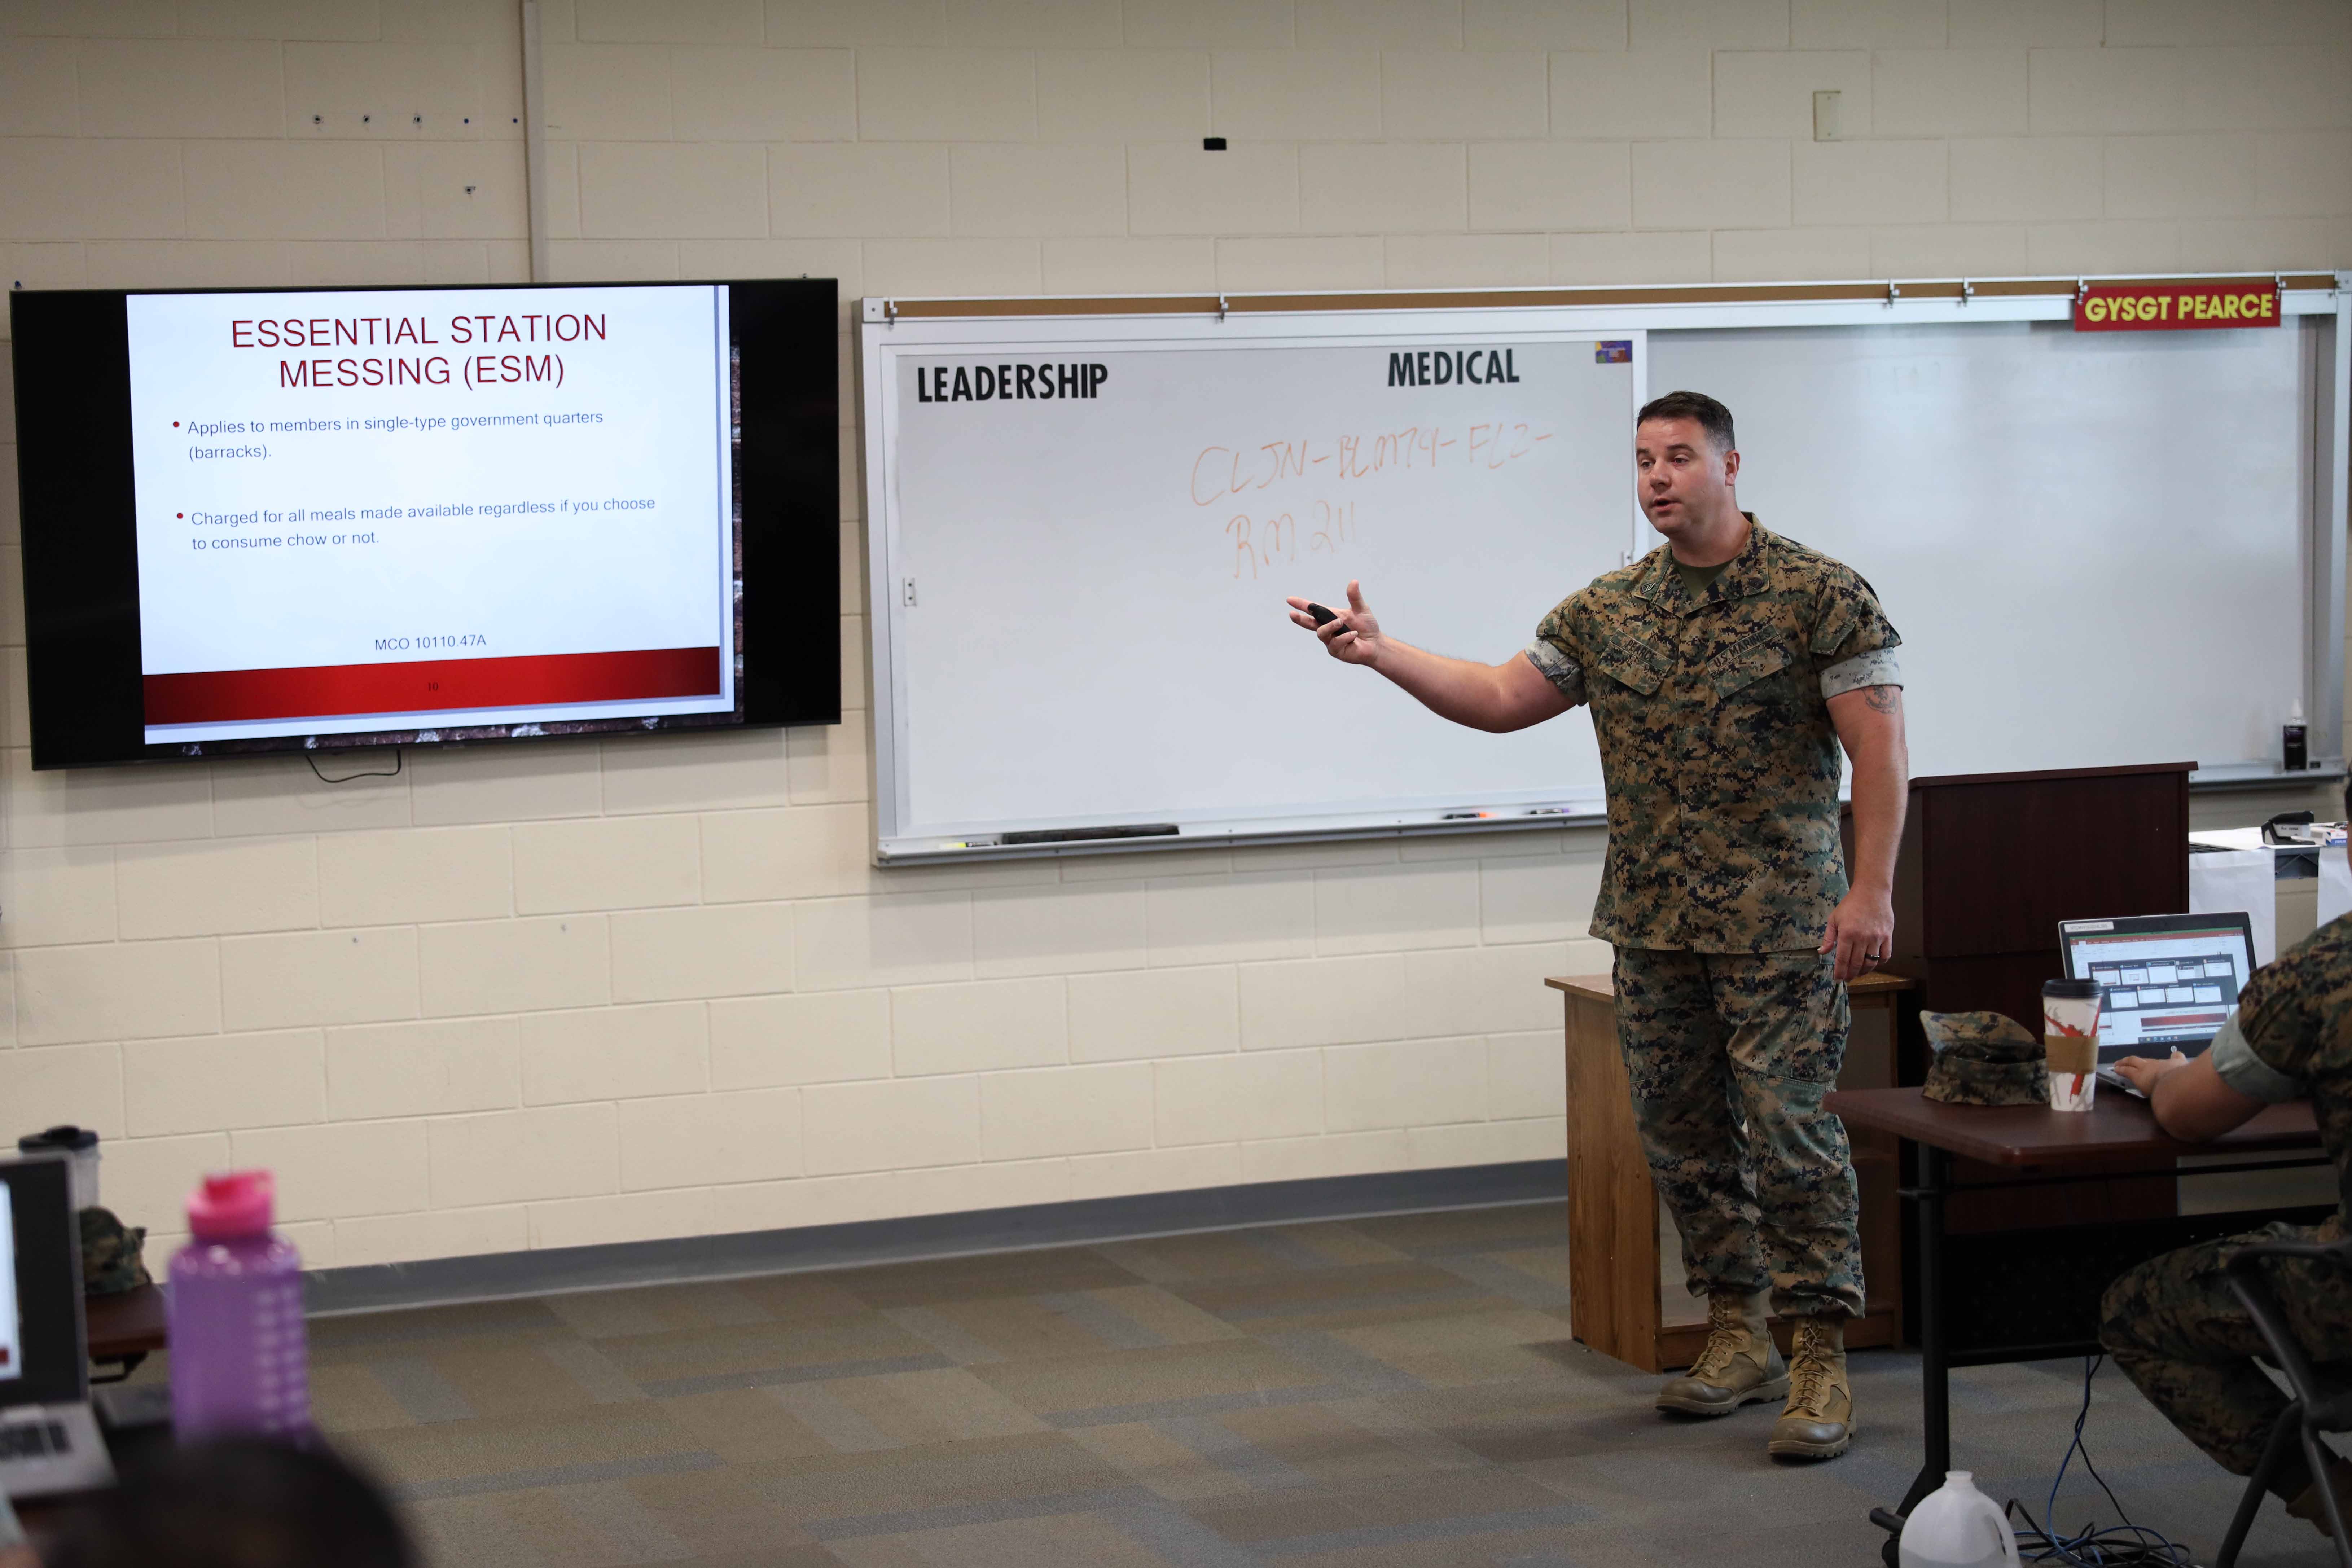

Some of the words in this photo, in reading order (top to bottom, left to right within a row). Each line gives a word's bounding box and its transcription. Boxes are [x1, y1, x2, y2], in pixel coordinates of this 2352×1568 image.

[2084, 295, 2171, 322] GYSGT
[2178, 294, 2272, 320] PEARCE
[232, 317, 439, 348] ESSENTIAL
[451, 313, 606, 344] STATION
[280, 357, 450, 388] MESSING
[464, 354, 564, 391] (ESM)
[1388, 348, 1519, 386] MEDICAL
[918, 364, 1108, 402] LEADERSHIP
[188, 420, 245, 437] Applies
[250, 421, 264, 432] to
[270, 418, 341, 432] members
[347, 417, 359, 430] in
[365, 416, 446, 432] single-type
[451, 413, 539, 430] government
[544, 412, 603, 427] quarters
[189, 444, 271, 462] (barracks).
[192, 510, 258, 527] Charged
[263, 510, 283, 523] for
[289, 509, 305, 522] all
[311, 508, 355, 521] meals
[361, 506, 403, 519] made
[408, 503, 474, 518] available
[479, 501, 555, 518] regardless
[561, 499, 568, 512] if
[572, 502, 598, 515] you
[604, 498, 655, 510] choose
[192, 538, 206, 550] to
[212, 537, 282, 549] consume
[287, 533, 327, 546] chow
[332, 535, 347, 544] or
[352, 532, 378, 544] not.
[1225, 514, 1296, 580] RM
[375, 638, 409, 650] MCO
[416, 634, 486, 649] 10110.47A
[1627, 639, 1657, 662] PEARCE
[1729, 630, 1771, 658] MARINES
[428, 682, 439, 691] 10
